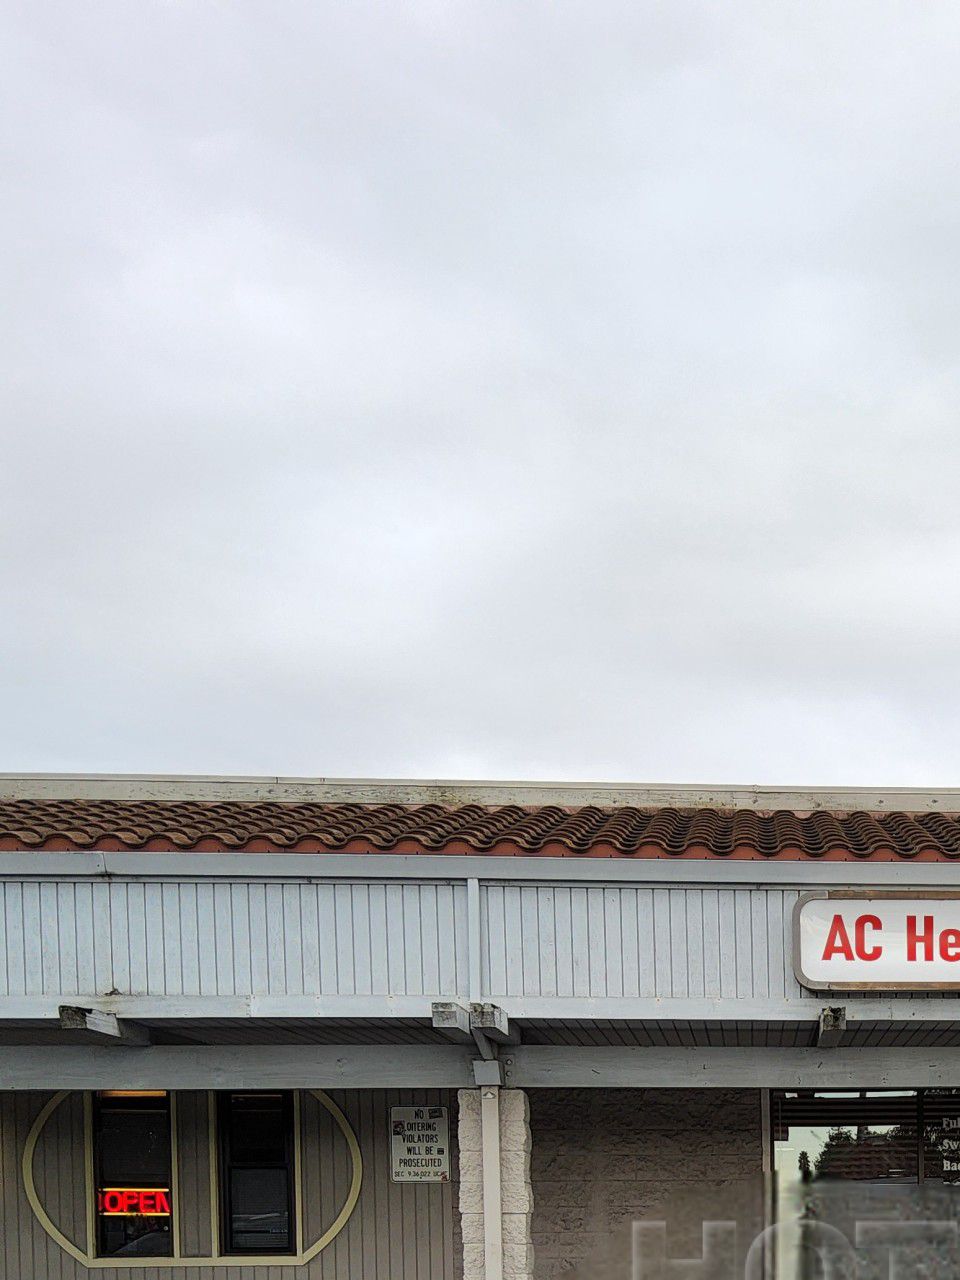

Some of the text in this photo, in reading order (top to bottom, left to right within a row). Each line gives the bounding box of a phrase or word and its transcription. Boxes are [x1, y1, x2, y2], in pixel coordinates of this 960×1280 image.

[821, 914, 883, 961] AC
[414, 1109, 424, 1120] NO
[404, 1122, 437, 1132] OITERING
[402, 1134, 439, 1144] VIOLATORS
[406, 1146, 422, 1156] WILL
[425, 1146, 434, 1156] BE
[399, 1158, 442, 1168] PROSECUTED
[104, 1191, 171, 1213] OPEN
